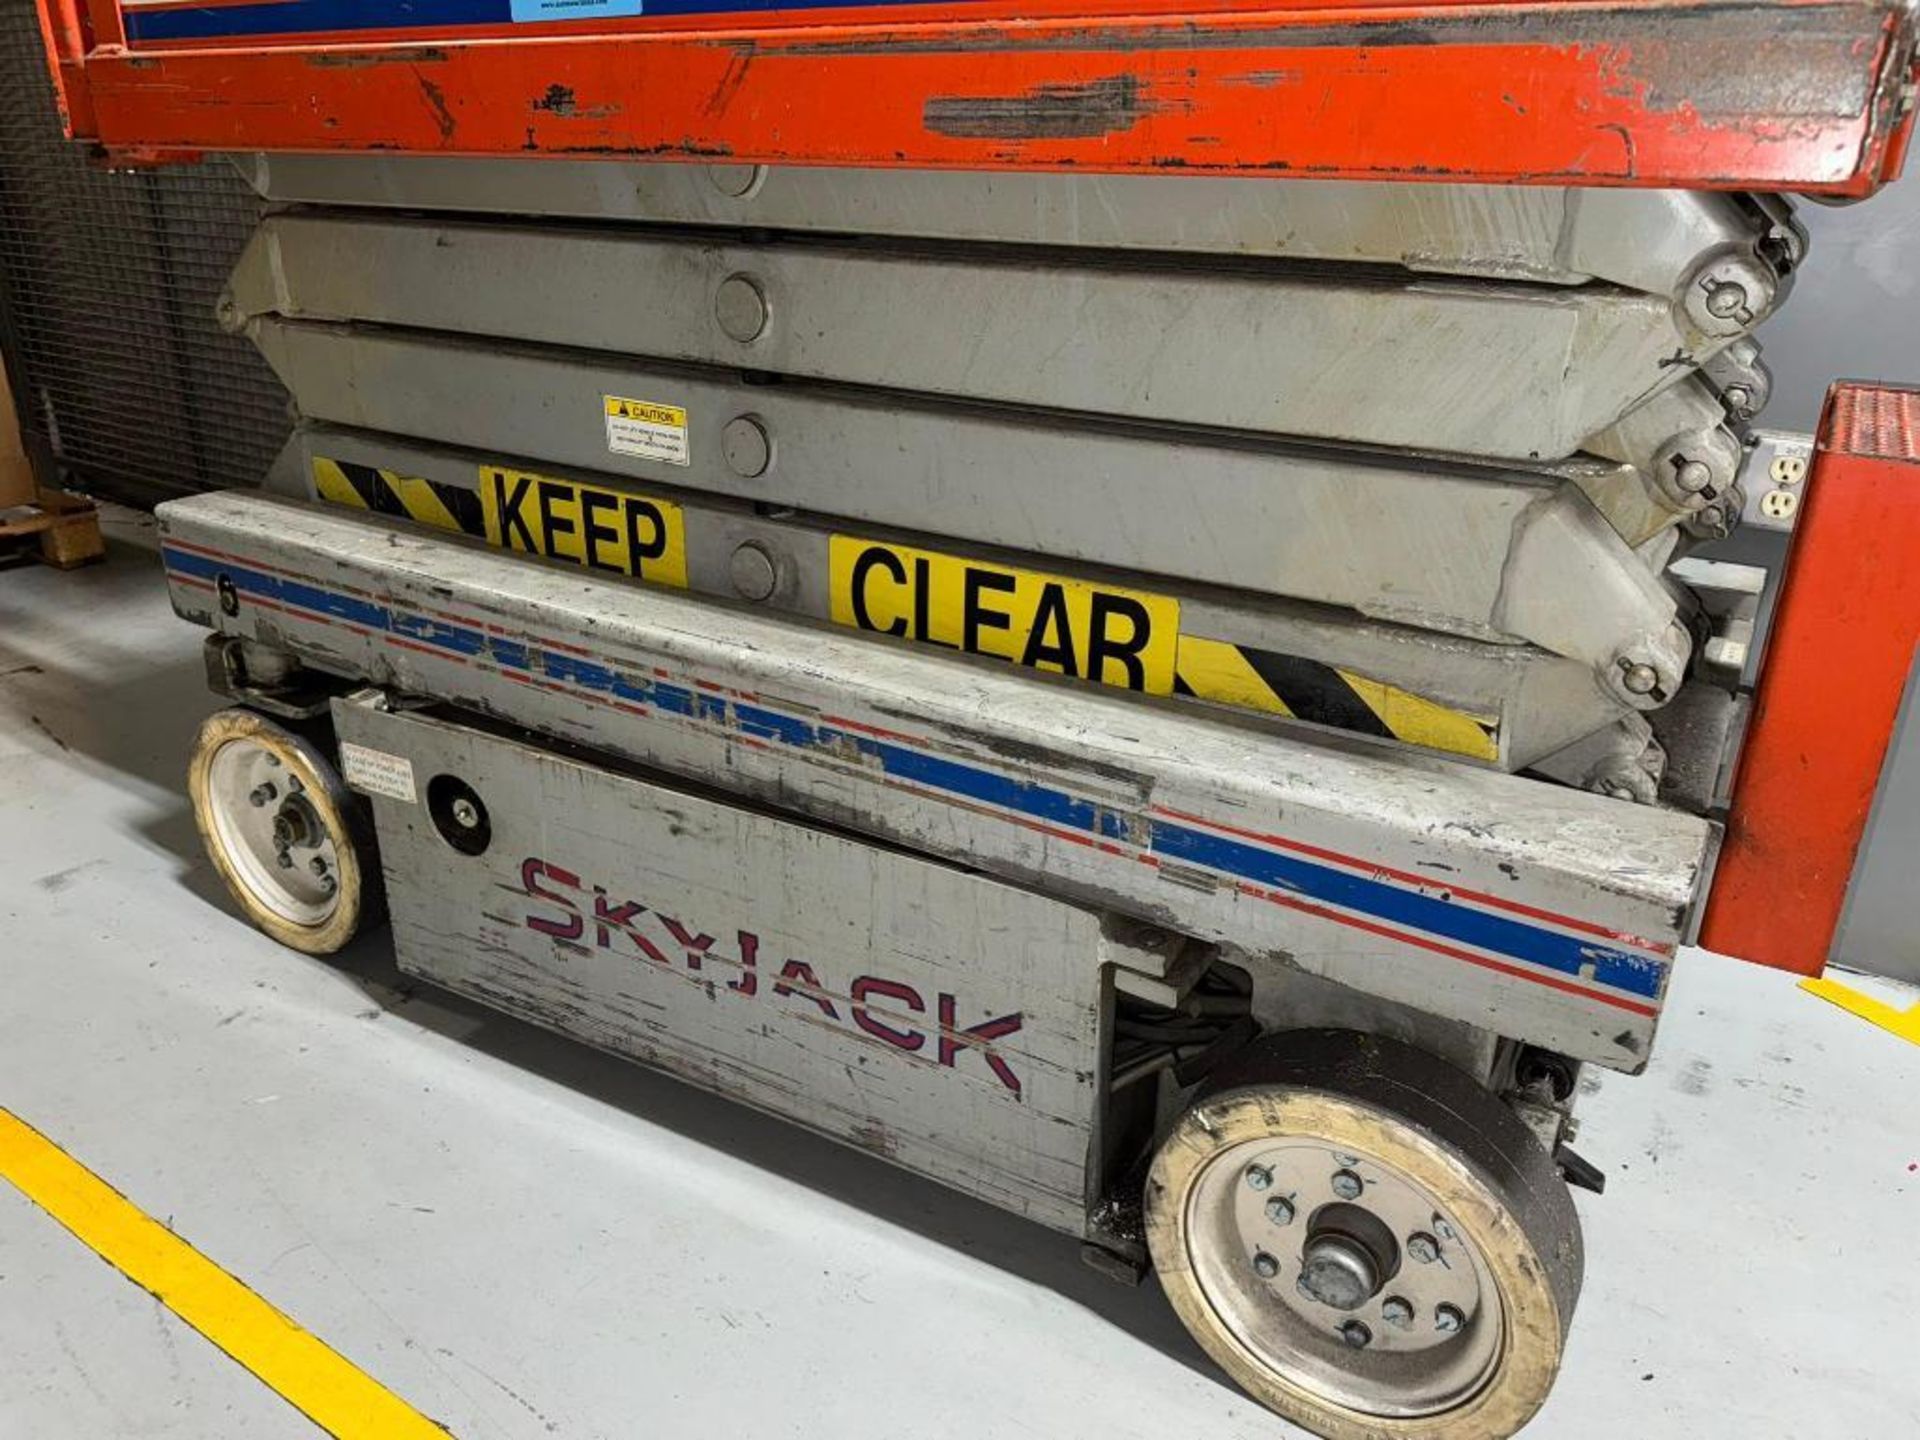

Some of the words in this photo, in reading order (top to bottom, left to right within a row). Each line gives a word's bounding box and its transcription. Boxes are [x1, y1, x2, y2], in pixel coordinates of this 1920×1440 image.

[632, 406, 674, 423] CAUTION
[494, 473, 666, 578] KEEP
[851, 546, 1151, 693] CLEAR
[521, 857, 1024, 1096] SKYJACK
